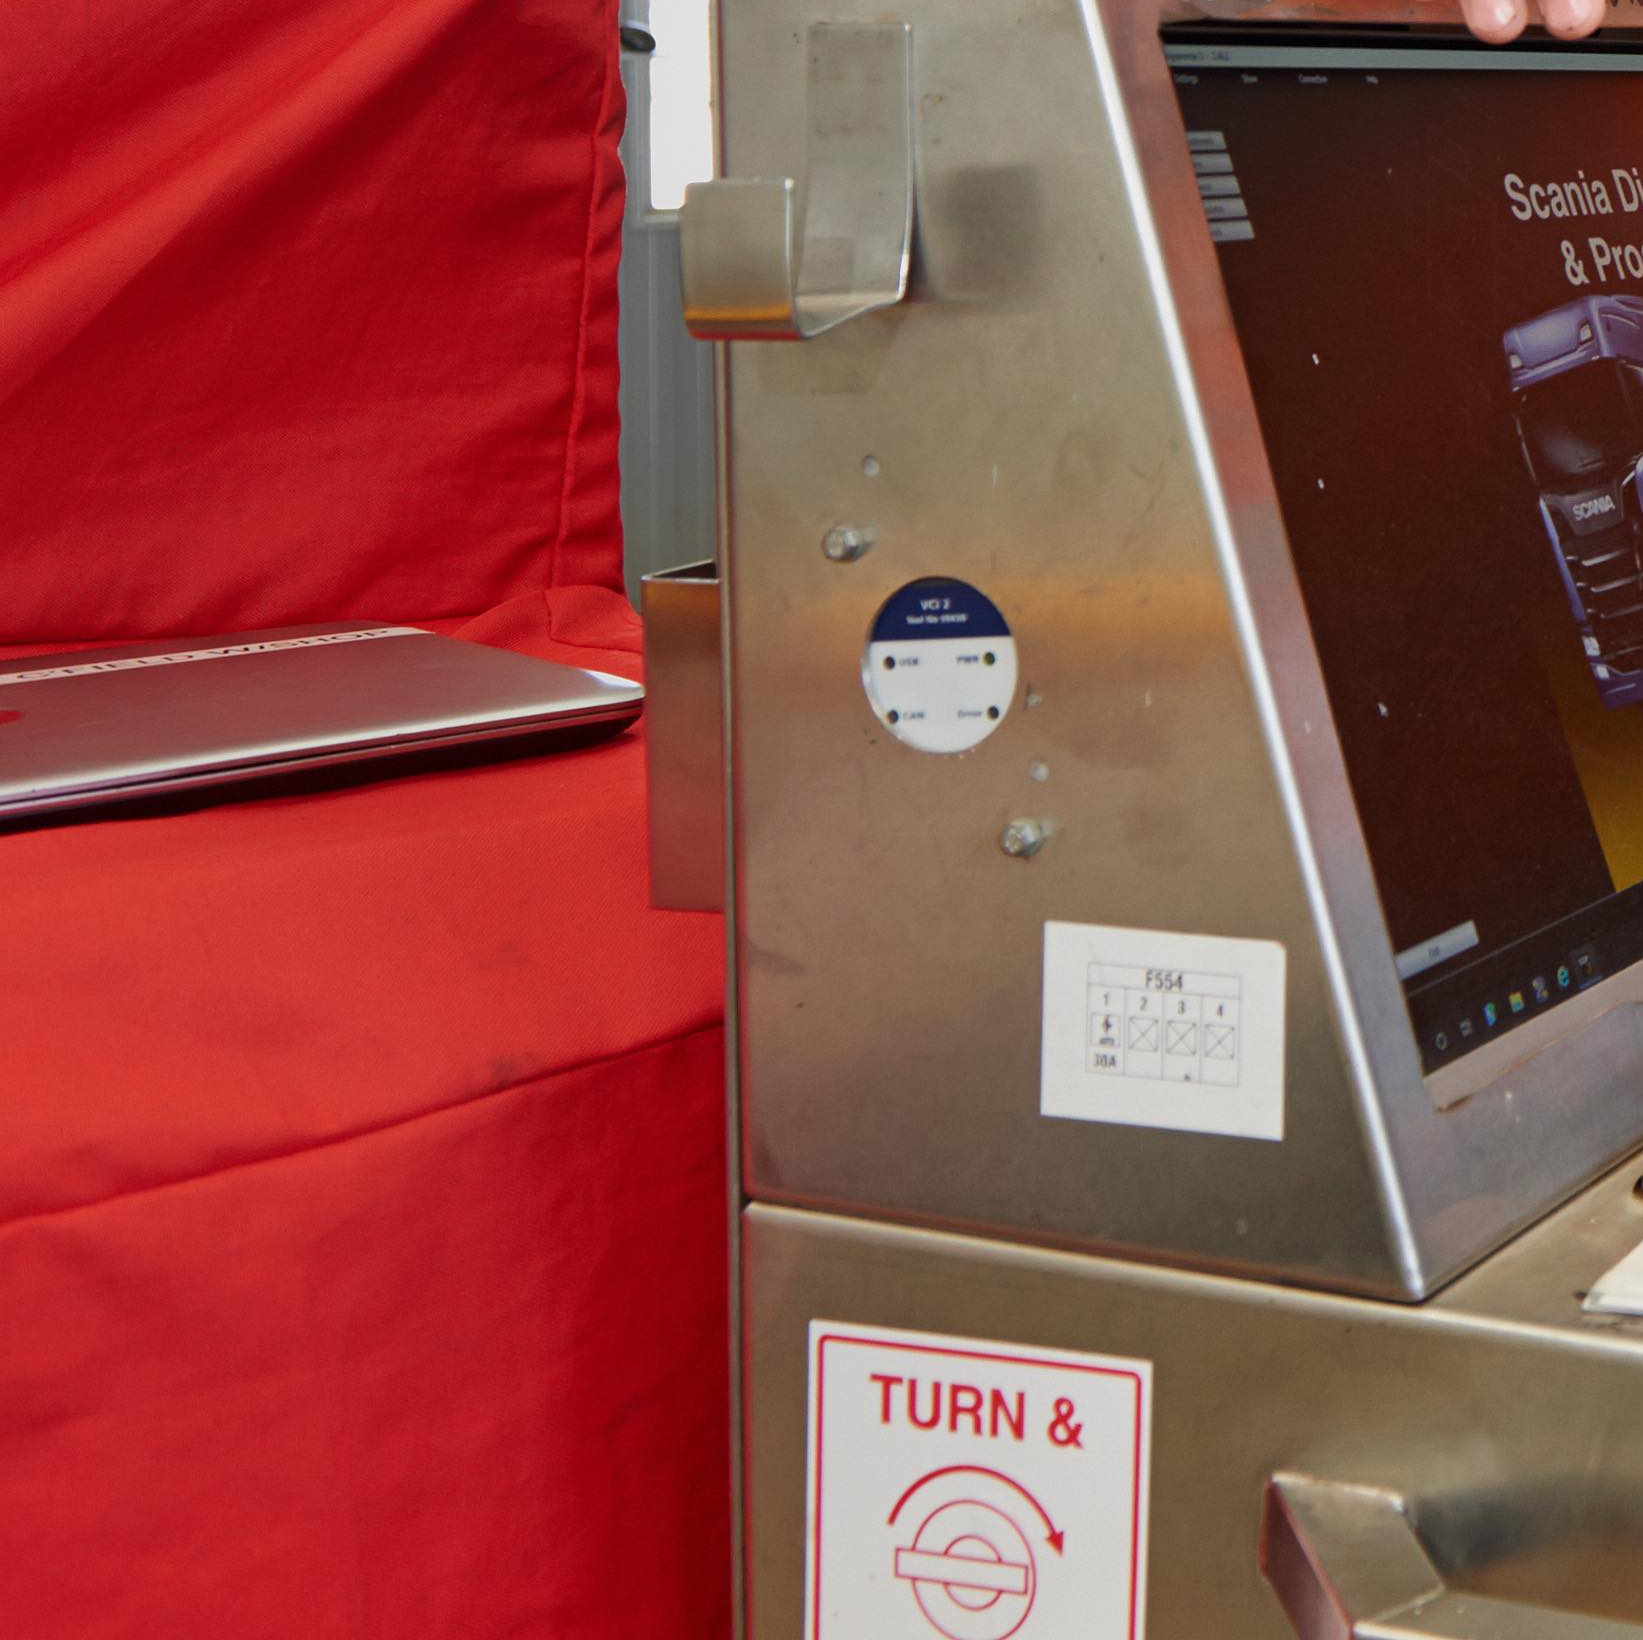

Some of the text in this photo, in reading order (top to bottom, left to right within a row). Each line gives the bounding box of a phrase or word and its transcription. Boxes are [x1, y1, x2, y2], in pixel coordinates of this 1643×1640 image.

[1504, 170, 1614, 220] Scania
[1560, 239, 1590, 286] &
[1145, 968, 1183, 992] F554
[1140, 995, 1148, 1011] 2
[1177, 999, 1186, 1016] 3
[1216, 1004, 1224, 1018] 4
[869, 1372, 1084, 1450] TURN &
